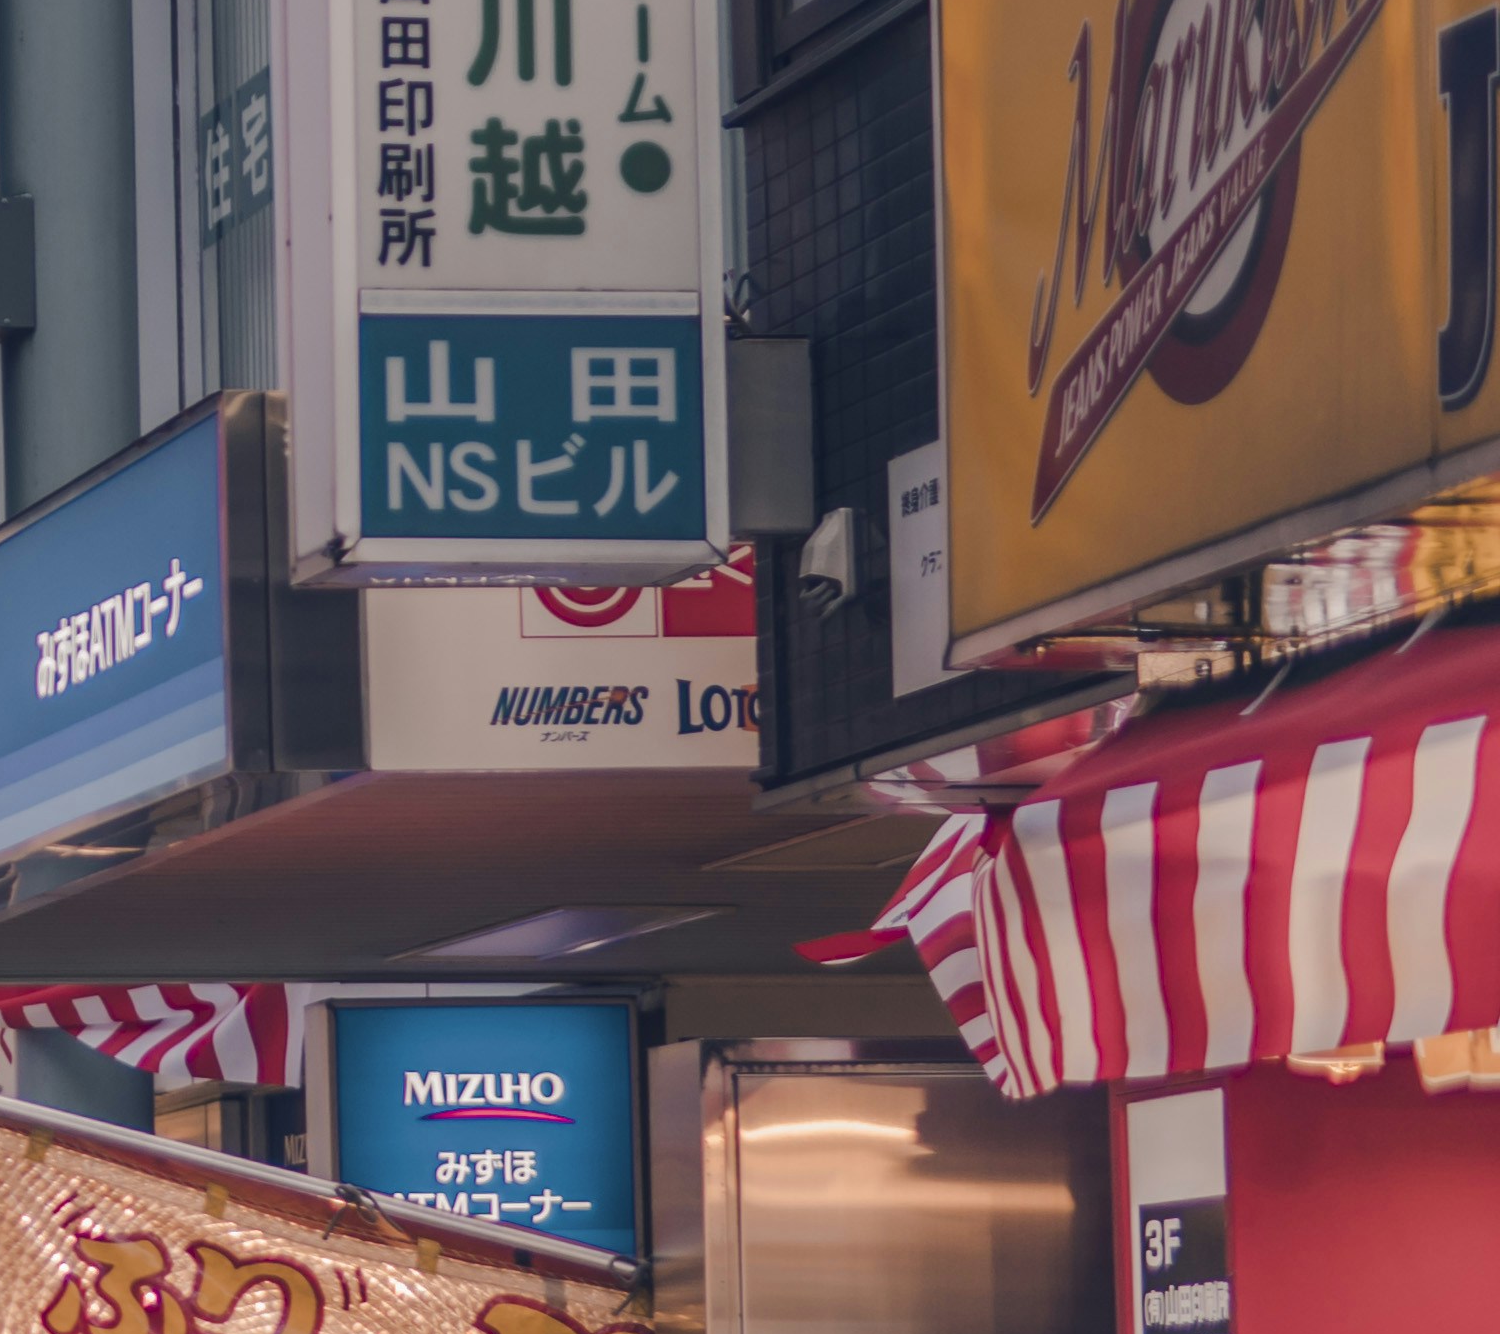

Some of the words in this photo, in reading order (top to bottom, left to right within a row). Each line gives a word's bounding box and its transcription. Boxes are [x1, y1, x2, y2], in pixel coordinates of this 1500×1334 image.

[204, 90, 269, 231] 住宅
[1055, 335, 1109, 459] JEANS
[1106, 263, 1164, 384] POWER
[1167, 194, 1218, 298] JEANS
[1219, 132, 1268, 227] VALUE
[385, 339, 679, 424] 山田
[387, 433, 681, 518] NSビル
[35, 557, 204, 699] みずほATMコーナー
[491, 685, 649, 728] NUMBERS
[540, 730, 589, 742] ナンバーズ
[403, 1070, 566, 1106] MIZUHO
[436, 1148, 538, 1185] みずほ
[393, 1188, 592, 1224] TMコーナー
[1144, 1217, 1181, 1269] 3F
